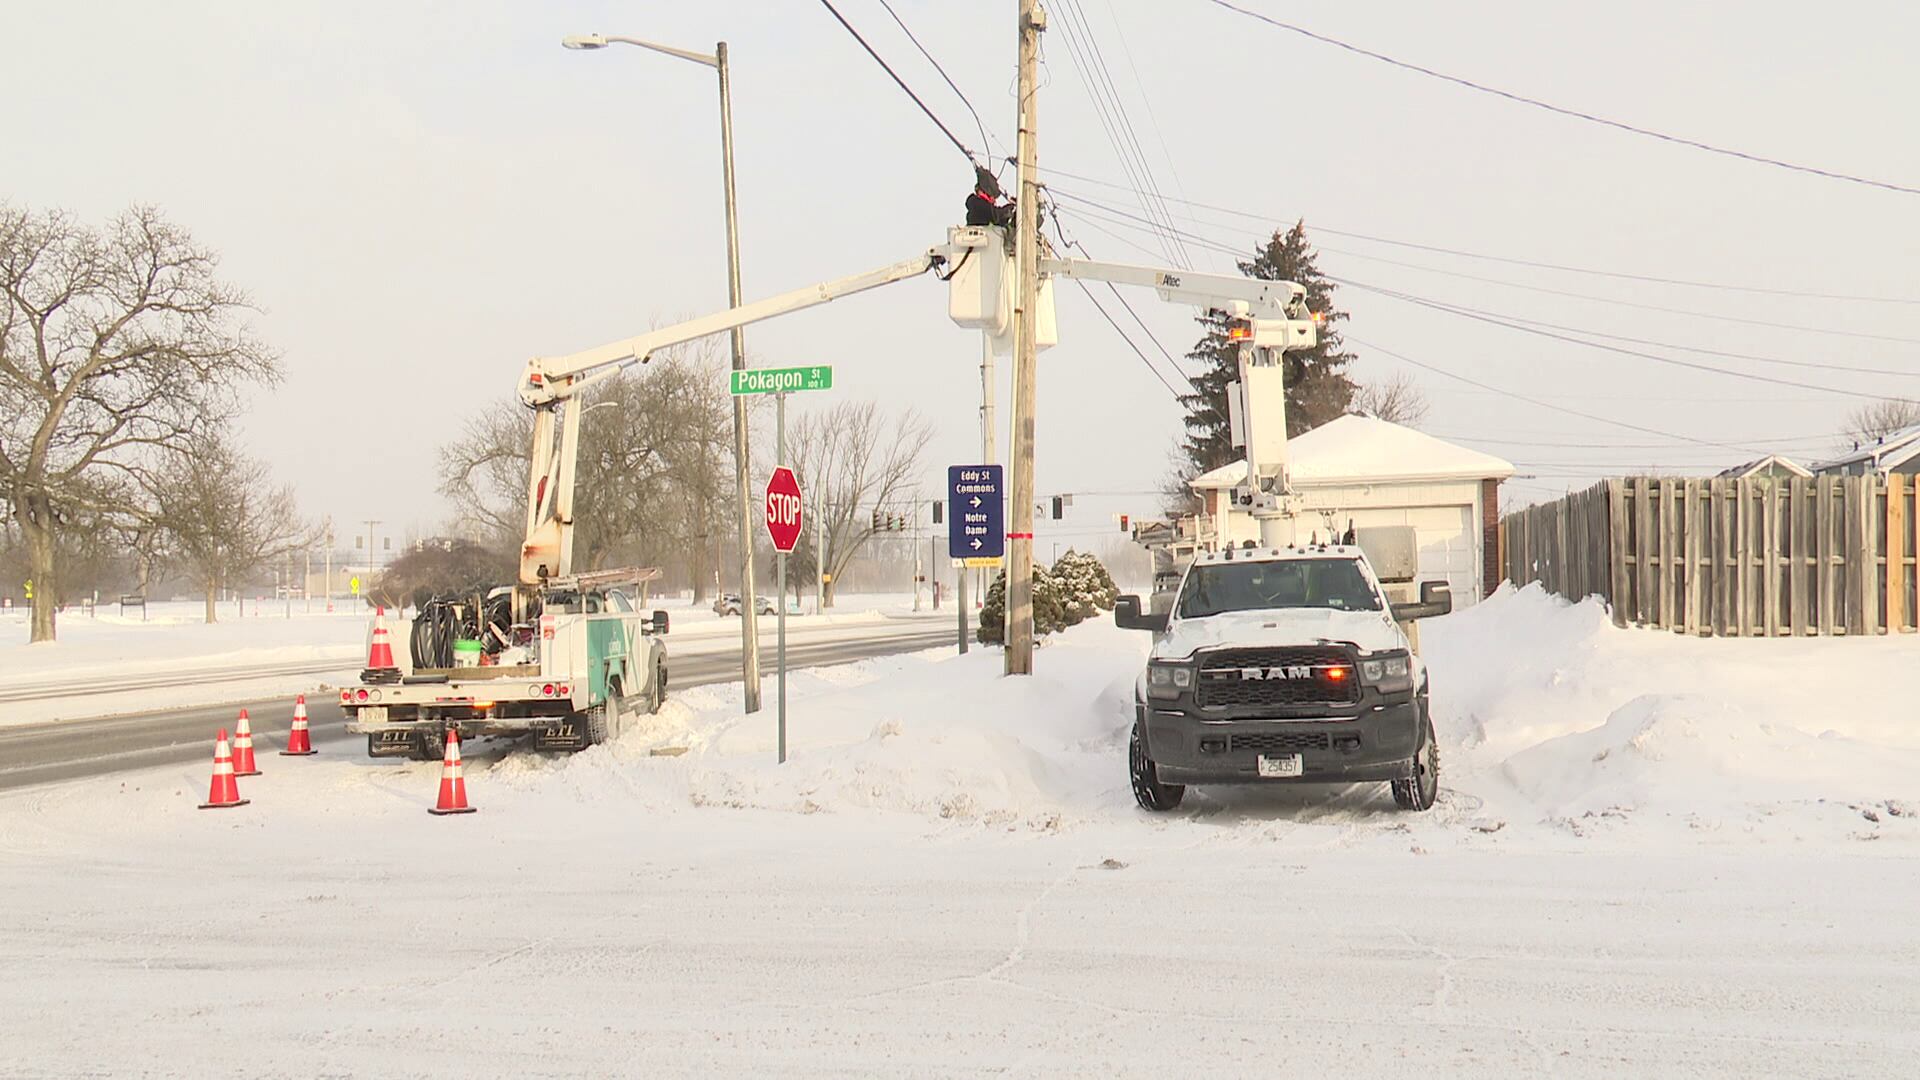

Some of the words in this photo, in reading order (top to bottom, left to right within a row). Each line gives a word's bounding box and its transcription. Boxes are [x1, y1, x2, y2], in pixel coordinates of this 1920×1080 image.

[1162, 273, 1180, 288] Altec
[811, 368, 821, 379] St
[738, 371, 803, 391] Pokagon
[960, 471, 980, 483] Eddy
[982, 470, 990, 481] St
[956, 484, 995, 494] Commons
[767, 492, 800, 526] STOP
[965, 513, 987, 522] Notre
[965, 526, 987, 535] Dame
[1241, 666, 1311, 681] RAM
[1268, 760, 1297, 772] 254357
